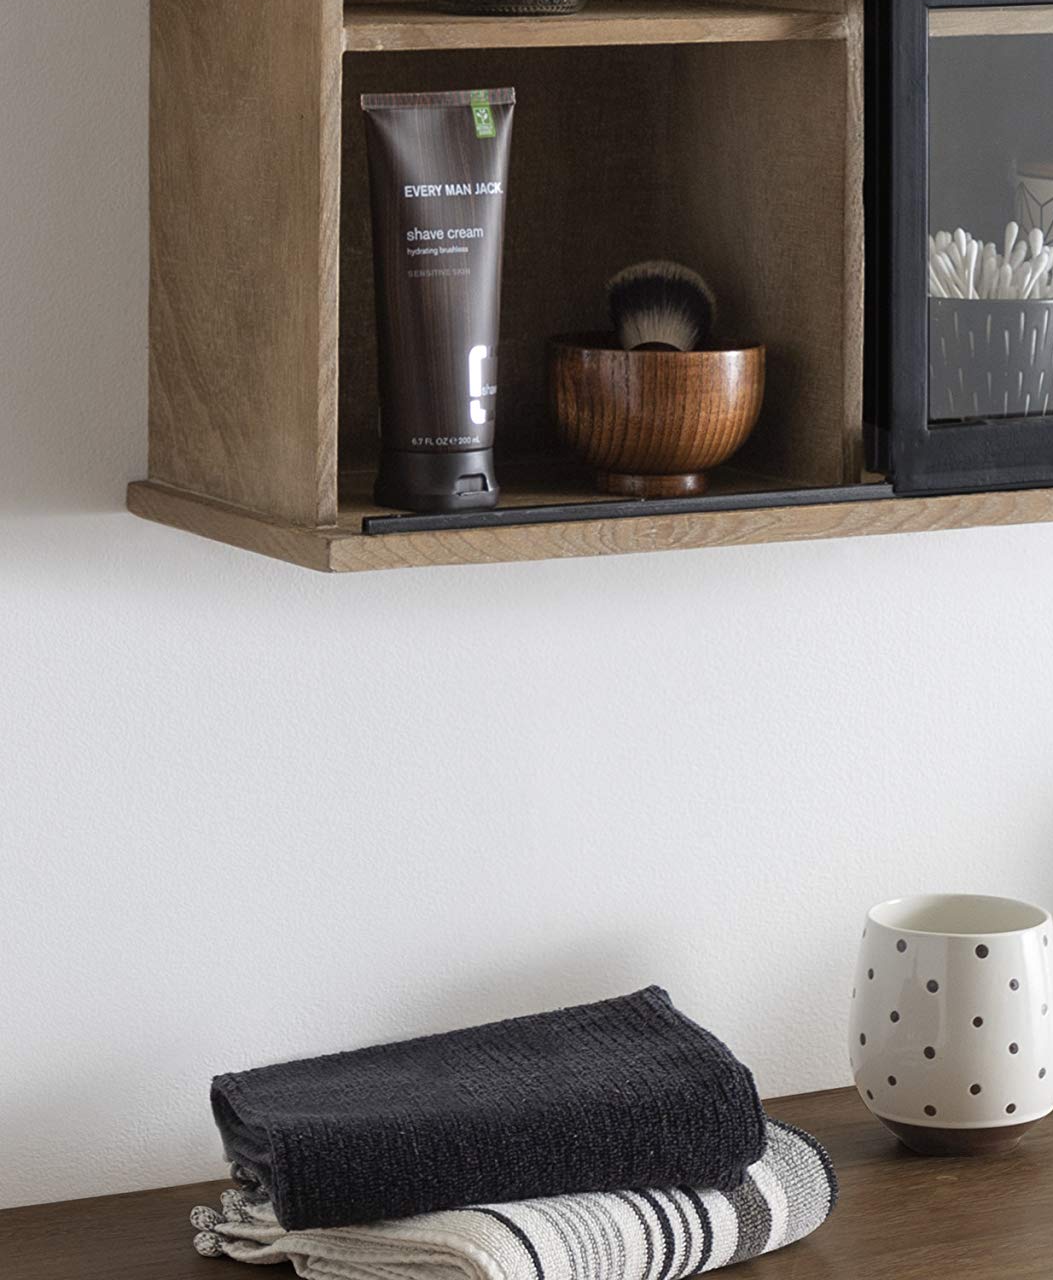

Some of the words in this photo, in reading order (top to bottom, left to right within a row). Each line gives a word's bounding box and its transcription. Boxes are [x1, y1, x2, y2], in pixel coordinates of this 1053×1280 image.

[404, 184, 442, 198] EVERY
[444, 183, 472, 196] MAN
[406, 227, 444, 241] shave
[447, 227, 484, 239] cream
